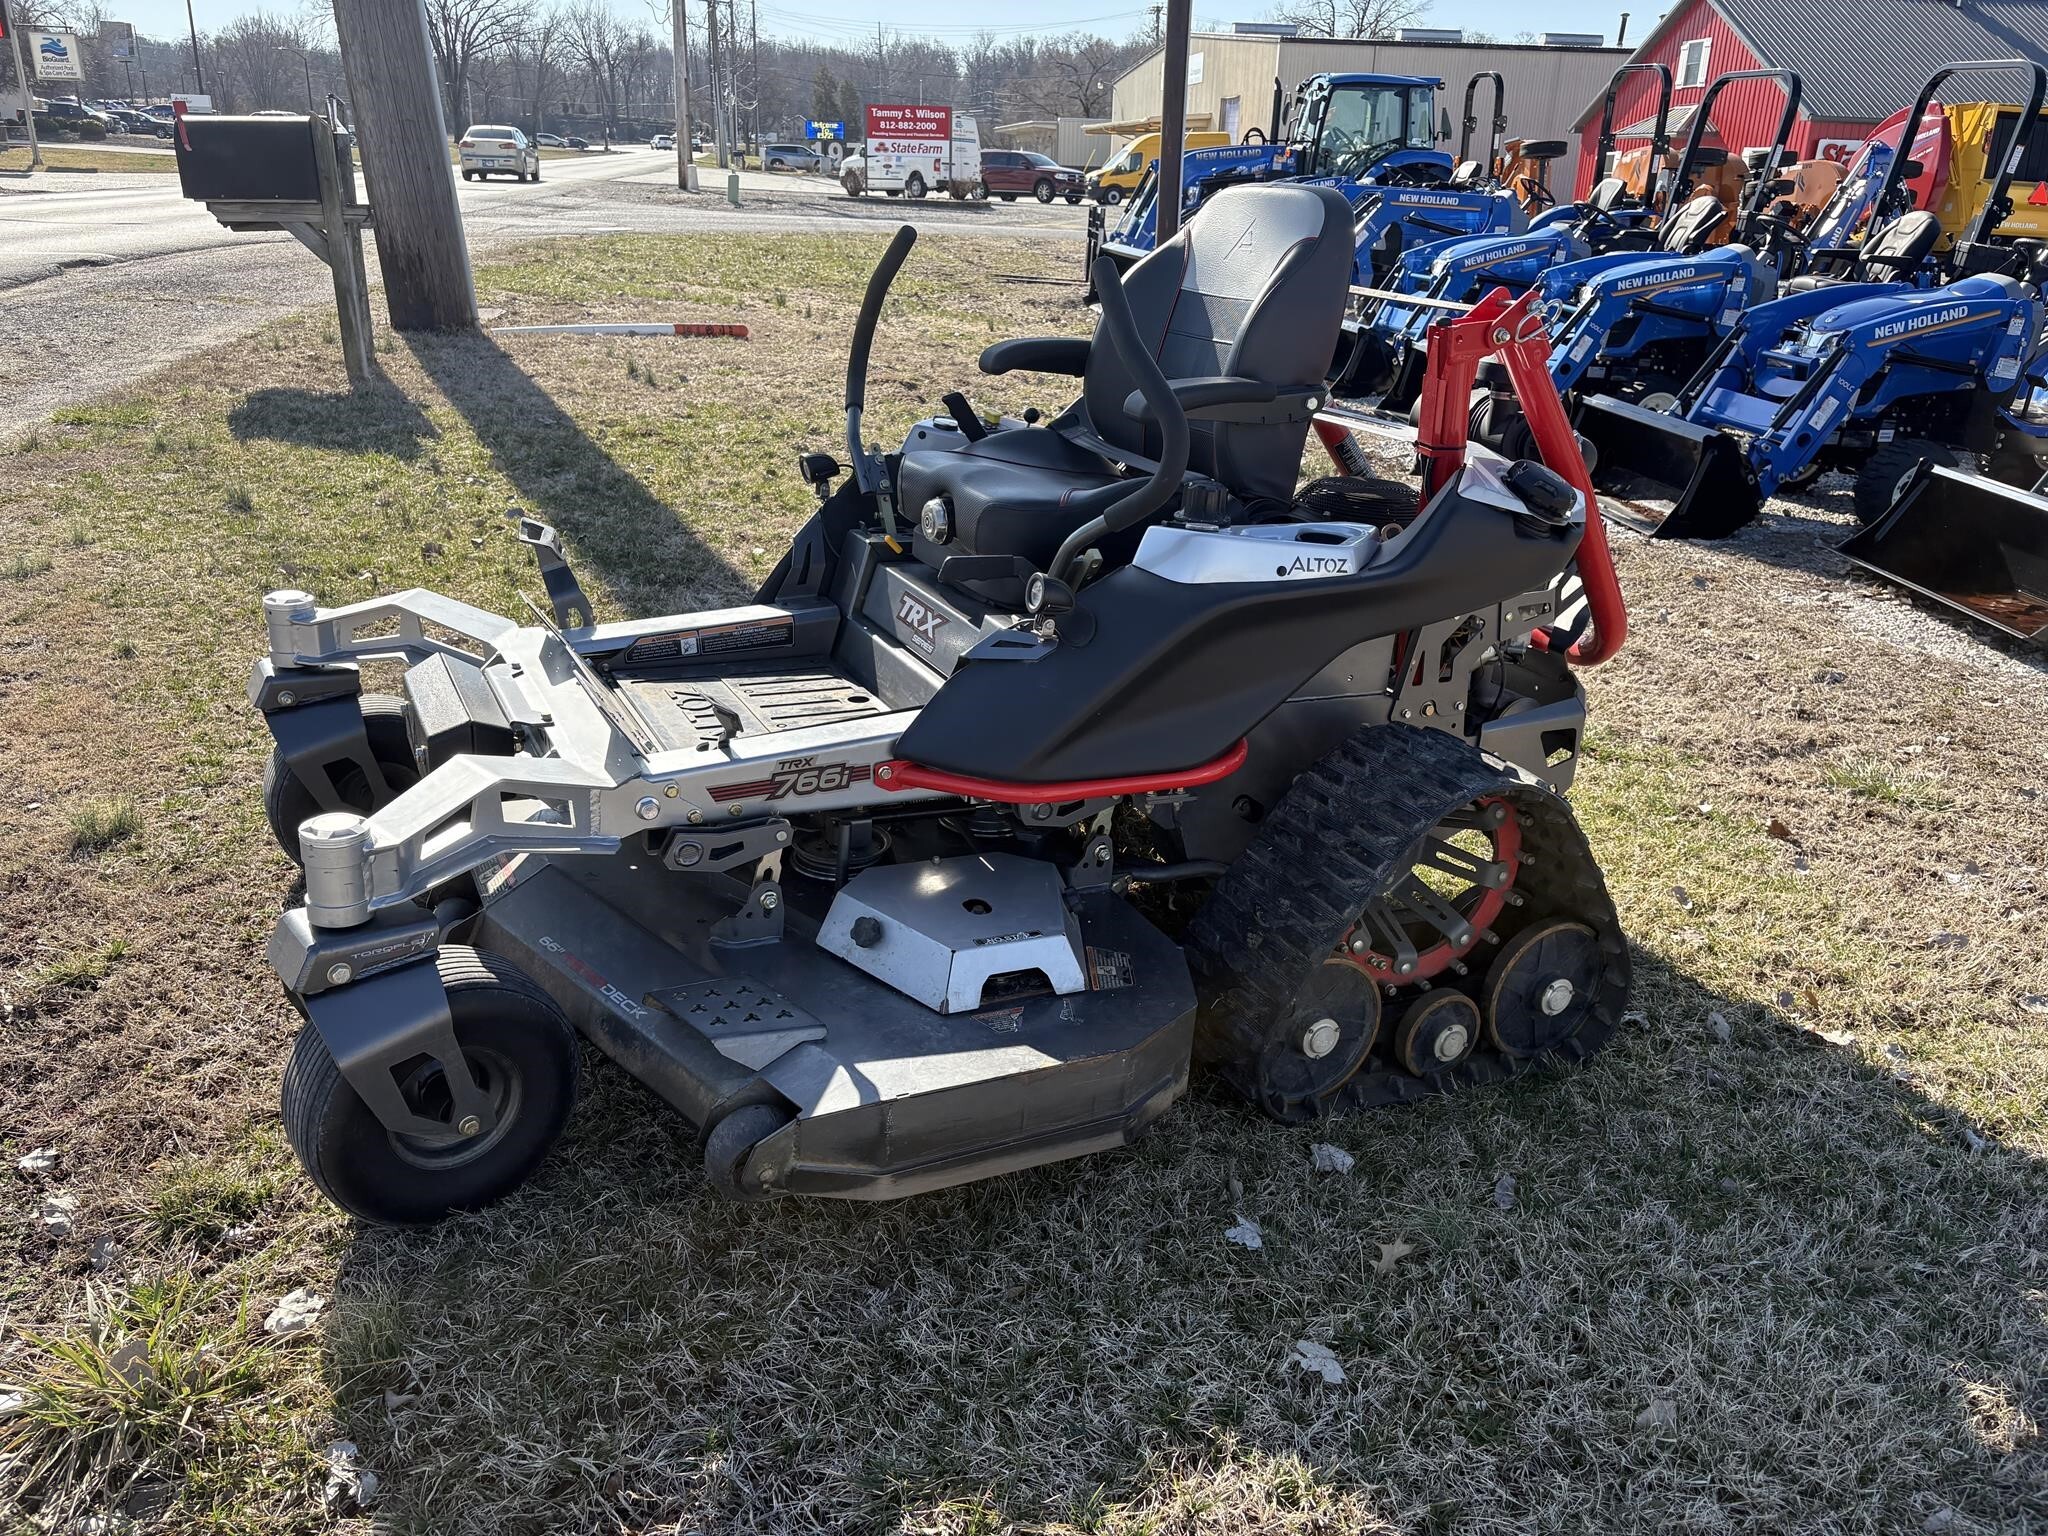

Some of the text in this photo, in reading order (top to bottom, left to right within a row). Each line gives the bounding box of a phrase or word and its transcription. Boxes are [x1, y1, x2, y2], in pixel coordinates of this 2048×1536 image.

[42, 55, 70, 63] BioGuard
[871, 107, 946, 120] Tammy S. Wilson
[879, 121, 937, 131] 812-882-2000
[1195, 148, 1262, 161] NEW HOLLAND
[1399, 193, 1460, 206] NEW HOLLAND
[1464, 255, 1486, 268] NEW
[1486, 243, 1527, 261] HOLLAND
[1617, 267, 1696, 291] NEW HOLLAND
[1874, 305, 1969, 339] NEW HOLLAND
[1286, 555, 1349, 576] ALTOZ
[899, 594, 943, 639] TRX
[911, 633, 935, 654] SERIES
[778, 756, 815, 771] TRX
[772, 765, 850, 800] 766i
[599, 983, 648, 1019] DECK
